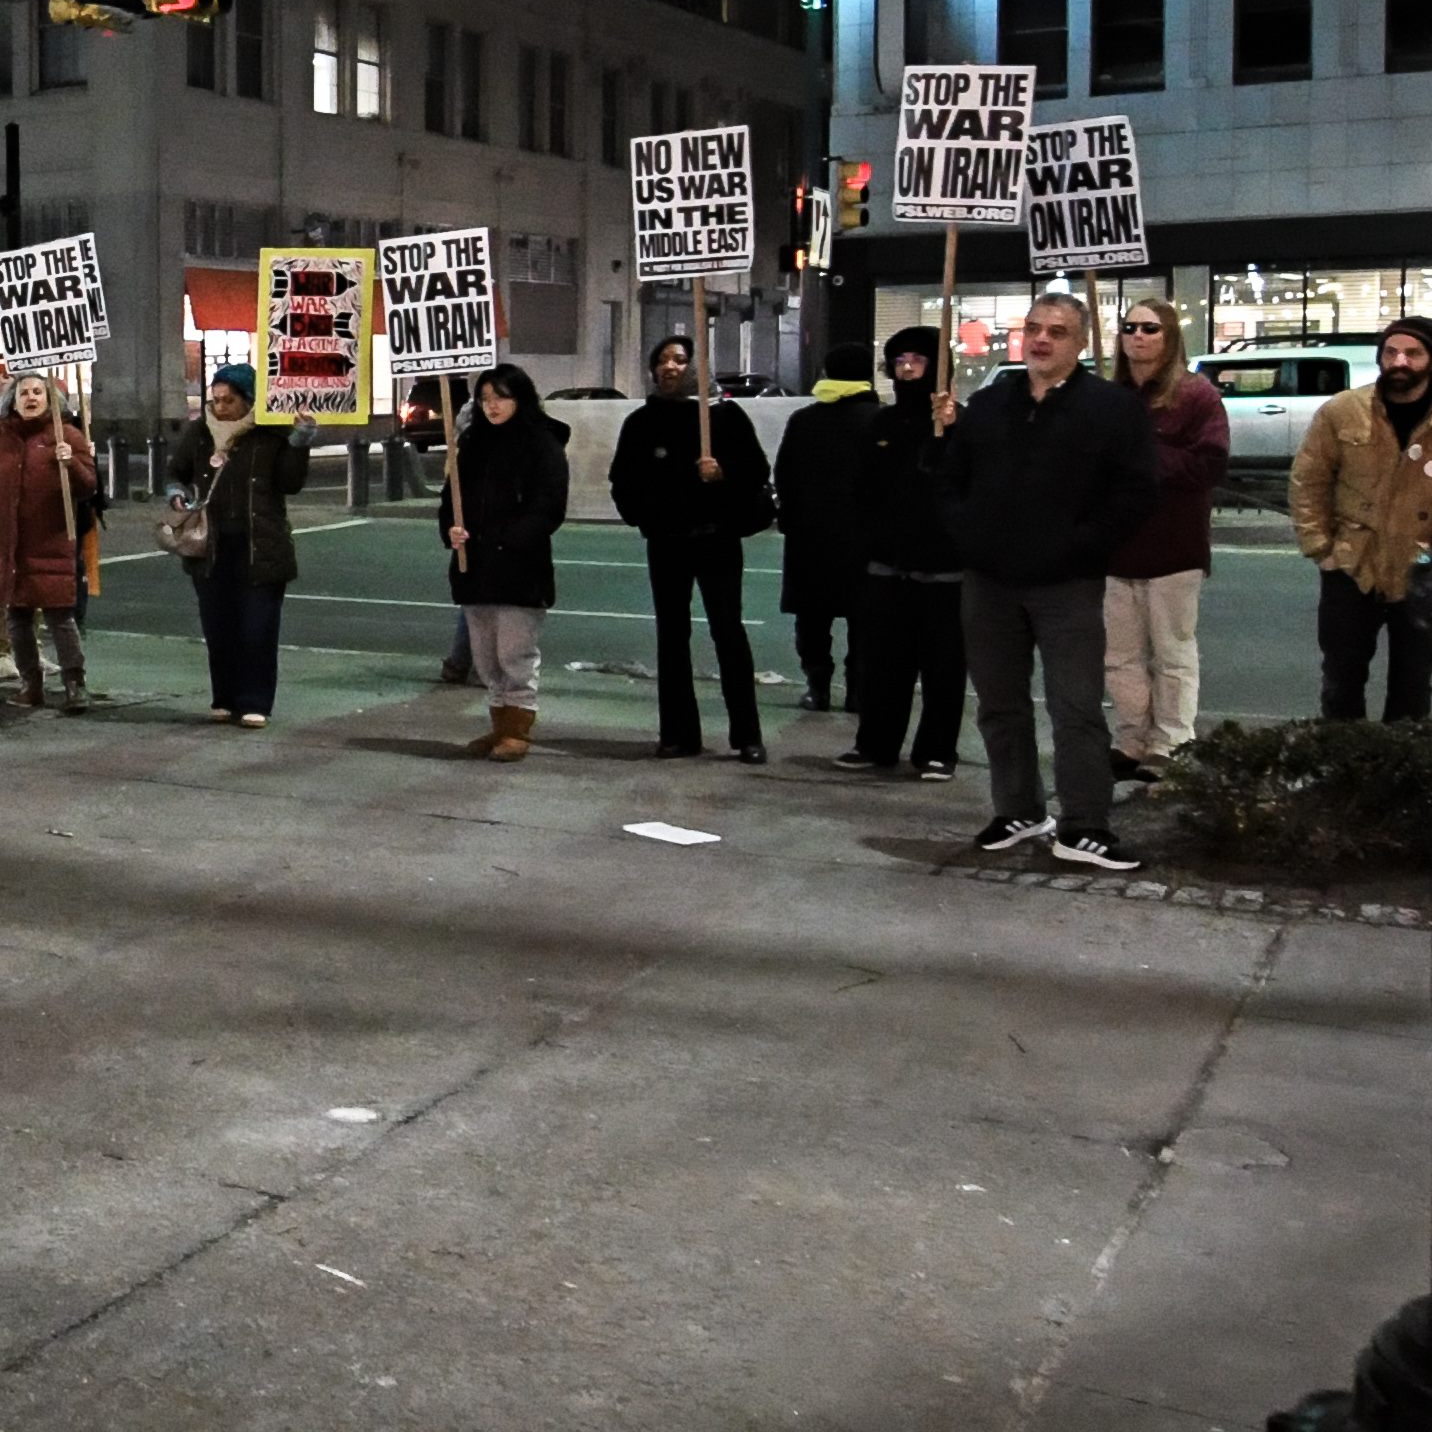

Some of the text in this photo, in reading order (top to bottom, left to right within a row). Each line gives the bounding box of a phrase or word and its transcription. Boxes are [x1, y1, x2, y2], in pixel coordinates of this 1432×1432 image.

[905, 73, 1028, 107] STOP THE
[904, 109, 1025, 142] WAR
[635, 132, 745, 177] NO NEW
[1026, 124, 1130, 165] STOP THE
[636, 171, 747, 205] US WAR
[898, 146, 1023, 200] ON IRAN!
[1025, 158, 1134, 196] WAR
[638, 202, 748, 231] IN THE
[896, 205, 1014, 220] PSLWEB.ORG
[1030, 194, 1141, 250] ON IRAN!
[383, 236, 485, 275] STOP THE
[639, 227, 748, 259] MIDDLE EAST
[1036, 250, 1144, 269] PSLWEB.ORG
[41, 246, 79, 276] THE
[385, 269, 488, 305] WAR
[290, 296, 329, 314] WAR
[0, 313, 31, 355] ON
[32, 303, 92, 351] IRAN!
[388, 301, 492, 355] ON IRAN!
[8, 349, 94, 370] PSLWEB.ORG
[392, 354, 491, 372] PSLWEB.ORG
